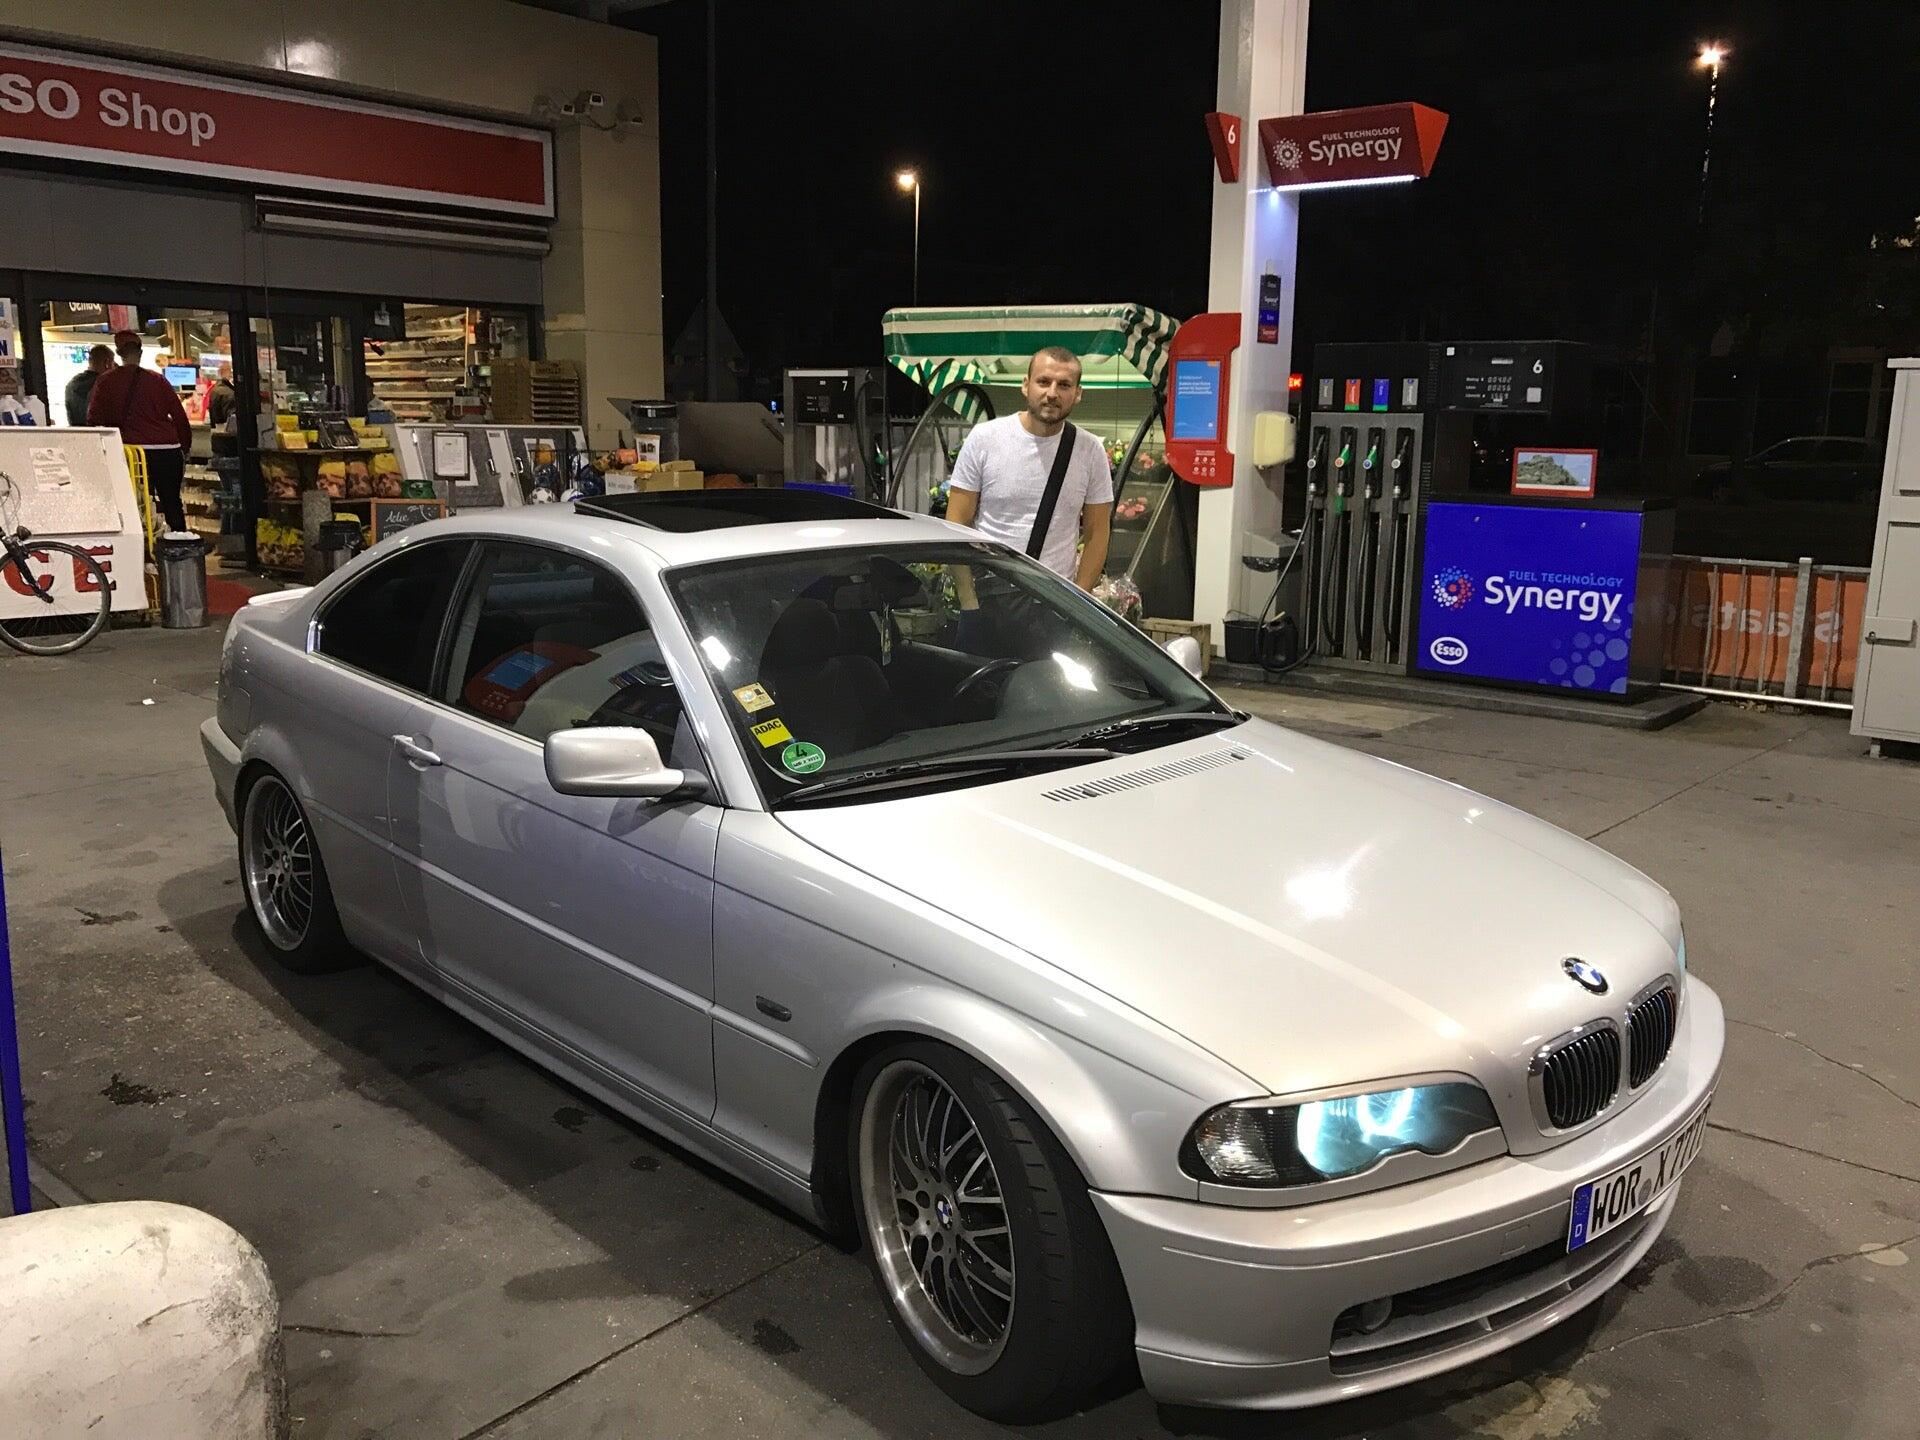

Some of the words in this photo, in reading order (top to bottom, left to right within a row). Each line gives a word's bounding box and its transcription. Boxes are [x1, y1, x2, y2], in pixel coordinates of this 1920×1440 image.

[99, 88, 216, 147] Shop
[1228, 124, 1236, 144] 6
[1322, 133, 1343, 141] FUEL
[1344, 126, 1400, 139] TECHNOLOGY
[1308, 137, 1402, 166] Synergy
[1533, 359, 1543, 374] 6
[842, 380, 849, 391] 7
[1509, 570, 1537, 581] FUEL
[1541, 572, 1624, 588] TECHNOLOGY
[1484, 575, 1622, 623] Synergy
[754, 720, 782, 736] ADAC
[796, 744, 808, 757] 4
[1591, 1165, 1642, 1234] WOR
[1653, 1145, 1672, 1194] X
[1574, 1223, 1583, 1238] D
